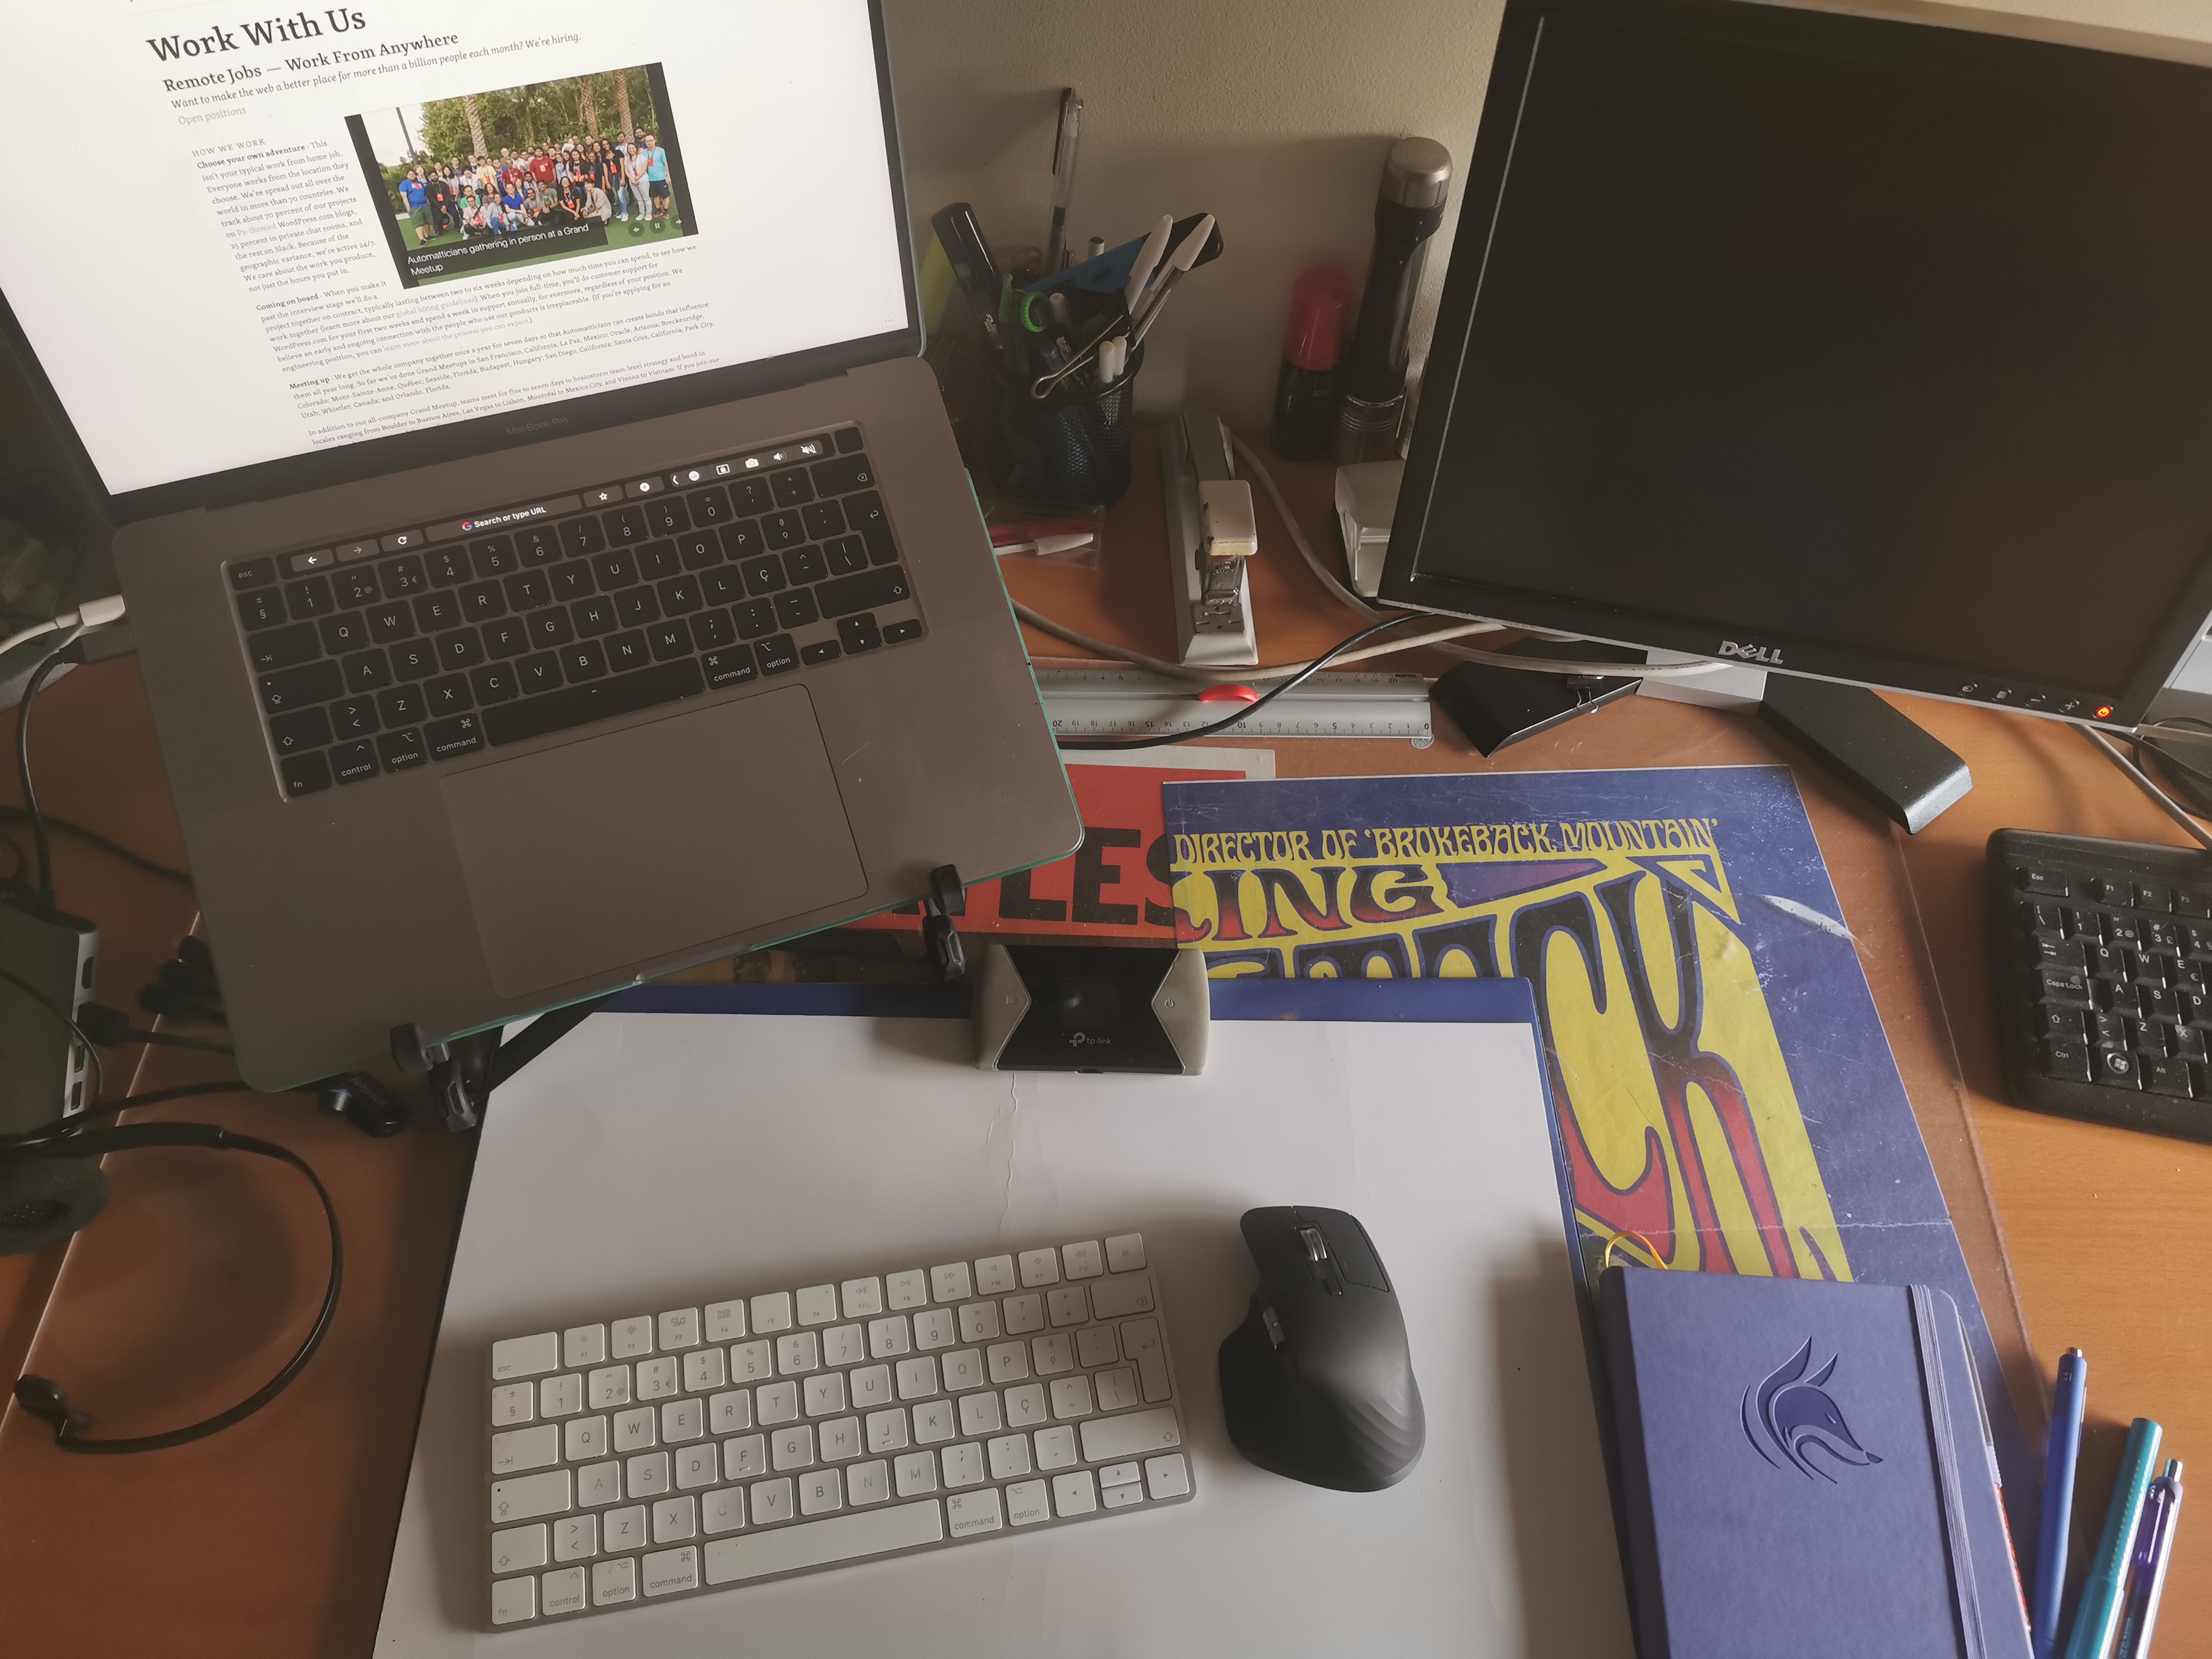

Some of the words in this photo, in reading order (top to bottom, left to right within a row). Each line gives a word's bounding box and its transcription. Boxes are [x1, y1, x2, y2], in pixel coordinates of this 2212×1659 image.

[145, 25, 241, 62] Work
[239, 11, 324, 47] With
[323, 7, 366, 33] Us
[162, 73, 226, 93] Remote
[226, 64, 263, 85] Jobs
[284, 52, 332, 72] Work
[331, 48, 377, 64] From
[379, 34, 459, 57] Anywhere
[170, 96, 199, 109] Want
[199, 95, 210, 105] to
[210, 90, 238, 102] make
[238, 87, 255, 98] the
[255, 82, 275, 95] web
[275, 84, 283, 92] a
[282, 79, 311, 90] better
[312, 74, 338, 89] place
[338, 70, 352, 84] for
[352, 68, 377, 79] more
[377, 63, 401, 75] than
[401, 62, 408, 71] a
[407, 57, 438, 69] billion
[438, 50, 468, 67] people
[469, 46, 490, 59] each
[490, 41, 524, 55] month?
[524, 36, 551, 49] We're
[551, 33, 581, 45] hiring.
[178, 115, 204, 127] Open
[204, 107, 247, 124] positions
[191, 147, 215, 158] HOW
[216, 144, 235, 153] WE
[235, 138, 266, 150] WORK
[196, 159, 226, 169] Choose
[226, 155, 246, 166] your
[246, 152, 265, 161] own
[264, 145, 306, 158] adventure
[309, 140, 328, 149] This
[206, 181, 243, 193] Everyone
[243, 176, 268, 187] works
[267, 173, 288, 183] from
[287, 170, 301, 179] the
[300, 165, 332, 176] location
[332, 162, 349, 170] they
[219, 170, 238, 181] your
[238, 163, 266, 176] typical
[265, 159, 287, 170] work
[286, 158, 307, 167] from
[305, 153, 328, 163] home
[264, 183, 290, 196] spread
[290, 182, 304, 190] out
[304, 178, 315, 188] all
[315, 177, 332, 186] over
[332, 174, 346, 183] the
[216, 204, 240, 216] world
[249, 201, 270, 210] more
[269, 198, 289, 206] than
[287, 196, 298, 204] 70
[335, 186, 350, 194] We
[220, 216, 242, 227] track
[241, 213, 264, 224] about
[263, 212, 275, 221] 70
[274, 206, 304, 220] percent
[304, 203, 313, 212] of
[313, 202, 327, 210] our
[327, 196, 358, 210] projects
[239, 236, 269, 250] percent
[277, 230, 306, 243] private
[305, 226, 323, 235] chat
[348, 217, 363, 227] and
[276, 213, 335, 229] WordPress.com
[407, 247, 469, 265] Automatticians
[468, 240, 509, 255] gathering
[508, 237, 517, 246] in
[517, 232, 547, 246] person
[547, 229, 557, 238] at
[563, 223, 589, 235] Grand
[410, 264, 444, 276] Meetup
[380, 394, 395, 403] and
[506, 421, 550, 435] MacBook
[474, 516, 501, 528] Search
[512, 510, 529, 520] type
[530, 506, 546, 515] URL
[238, 570, 253, 579] esc
[338, 626, 349, 638] Q
[383, 615, 397, 627] W
[432, 605, 442, 617] E
[477, 594, 488, 606] R
[521, 583, 531, 595] T
[566, 574, 575, 585] Y
[609, 563, 620, 575] U
[655, 554, 661, 565] I
[695, 543, 705, 555] O
[737, 534, 746, 545] P
[1717, 640, 1783, 665] DELL
[292, 780, 304, 789] fn
[340, 762, 372, 777] control
[390, 752, 419, 765] option
[436, 736, 477, 753] command
[713, 666, 751, 682] command
[766, 657, 791, 669] option
[1173, 830, 1315, 864] DIRECTOR
[1321, 829, 1357, 860] OF
[1364, 822, 1555, 857] 'BROKEBACK
[1560, 817, 1718, 852] MOUNTAIN'
[2031, 873, 2044, 881] Esc
[2046, 979, 2065, 988] Caps
[2065, 980, 2083, 990] Lock
[2056, 1050, 2069, 1059] Ctrl
[497, 1364, 512, 1373] esc
[581, 1431, 591, 1444] Q
[627, 1422, 641, 1435] W
[677, 1413, 686, 1426] E
[725, 1404, 734, 1418] R
[771, 1396, 780, 1409] T
[819, 1387, 828, 1399] Y
[865, 1379, 875, 1392] U
[914, 1372, 919, 1384] I
[957, 1362, 967, 1375] O
[1002, 1355, 1011, 1367] P
[498, 1607, 508, 1617] fn
[549, 1594, 580, 1608] control
[602, 1586, 631, 1598] option
[649, 1574, 692, 1589] command
[953, 1515, 995, 1531] command
[1013, 1508, 1041, 1521] option
